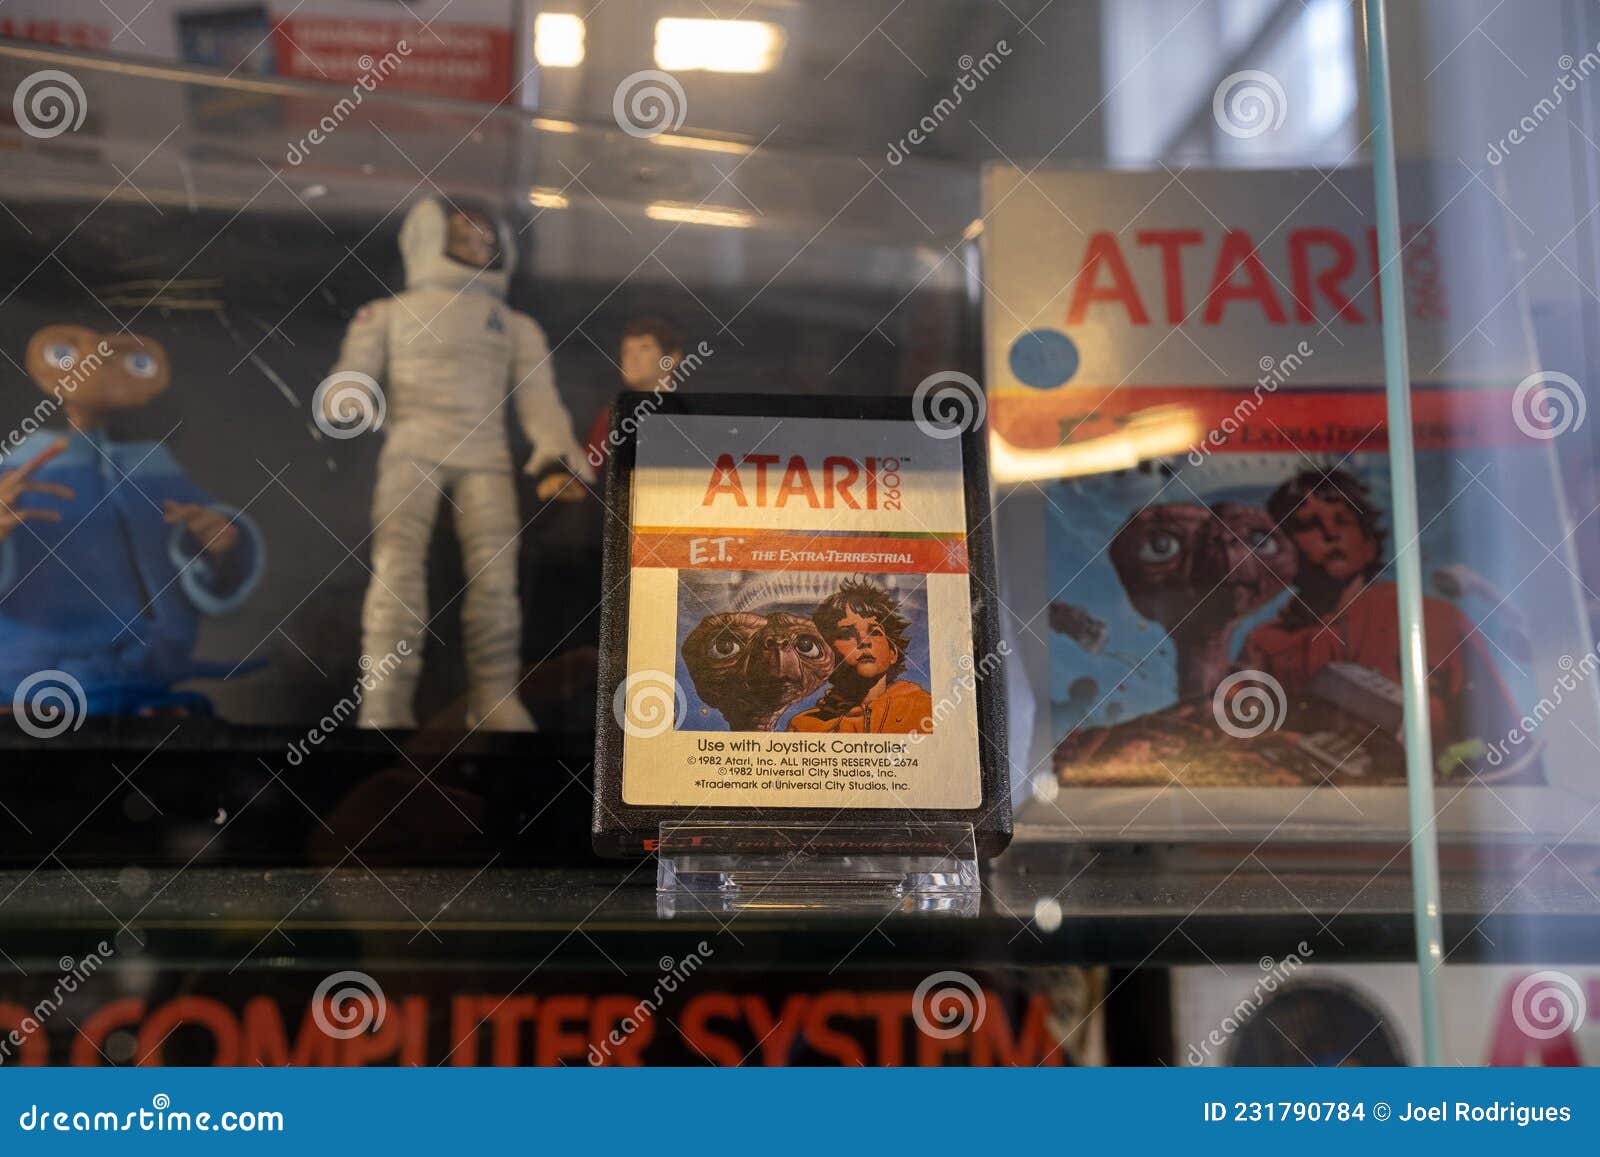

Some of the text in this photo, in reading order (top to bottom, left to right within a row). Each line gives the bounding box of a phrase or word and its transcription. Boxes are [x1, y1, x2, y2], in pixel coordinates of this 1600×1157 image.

[702, 453, 878, 510] ATARI
[882, 456, 901, 511] 2600
[751, 550, 777, 561] THE
[779, 549, 914, 564] EXTRA-TERRESTRIAL
[698, 739, 907, 754] Use with Joystick Controller
[699, 756, 721, 765] 1982
[725, 757, 753, 766] Atari,
[757, 757, 777, 766] Inc.
[780, 758, 799, 766] ALL
[802, 758, 838, 767] RIGHTS
[842, 758, 891, 767] RESERVED
[894, 759, 918, 767] 2674
[729, 767, 752, 776] 1982
[756, 768, 804, 776] Universal
[808, 768, 829, 778] City
[833, 769, 874, 778] Studios,
[877, 769, 897, 777] Inc.
[761, 780, 773, 789] of
[775, 780, 822, 790] Universal
[825, 781, 845, 791] City
[849, 781, 889, 791] Studios,
[892, 782, 911, 790] Inc.
